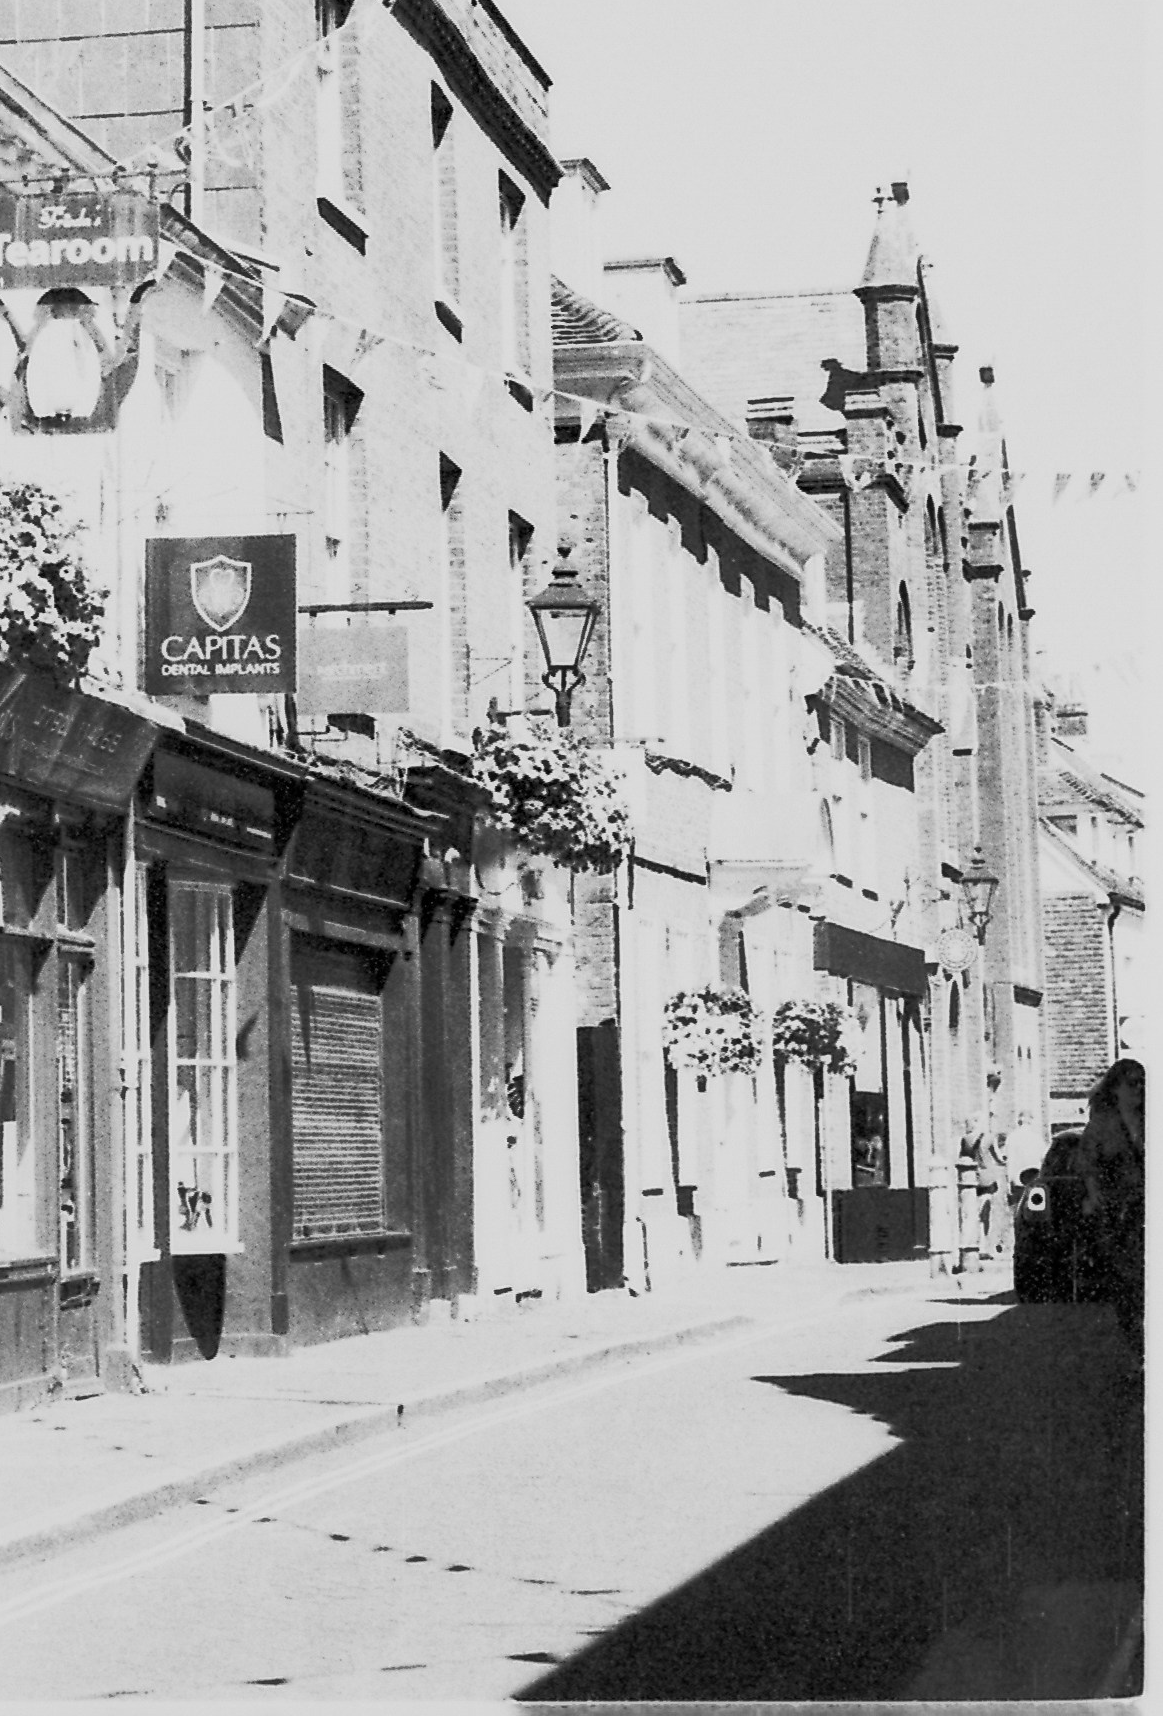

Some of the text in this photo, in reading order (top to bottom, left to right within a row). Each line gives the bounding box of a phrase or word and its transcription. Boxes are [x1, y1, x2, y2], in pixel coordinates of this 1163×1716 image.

[161, 634, 281, 661] CAPITAS
[161, 662, 280, 676] DENTAL IMPLANTS
